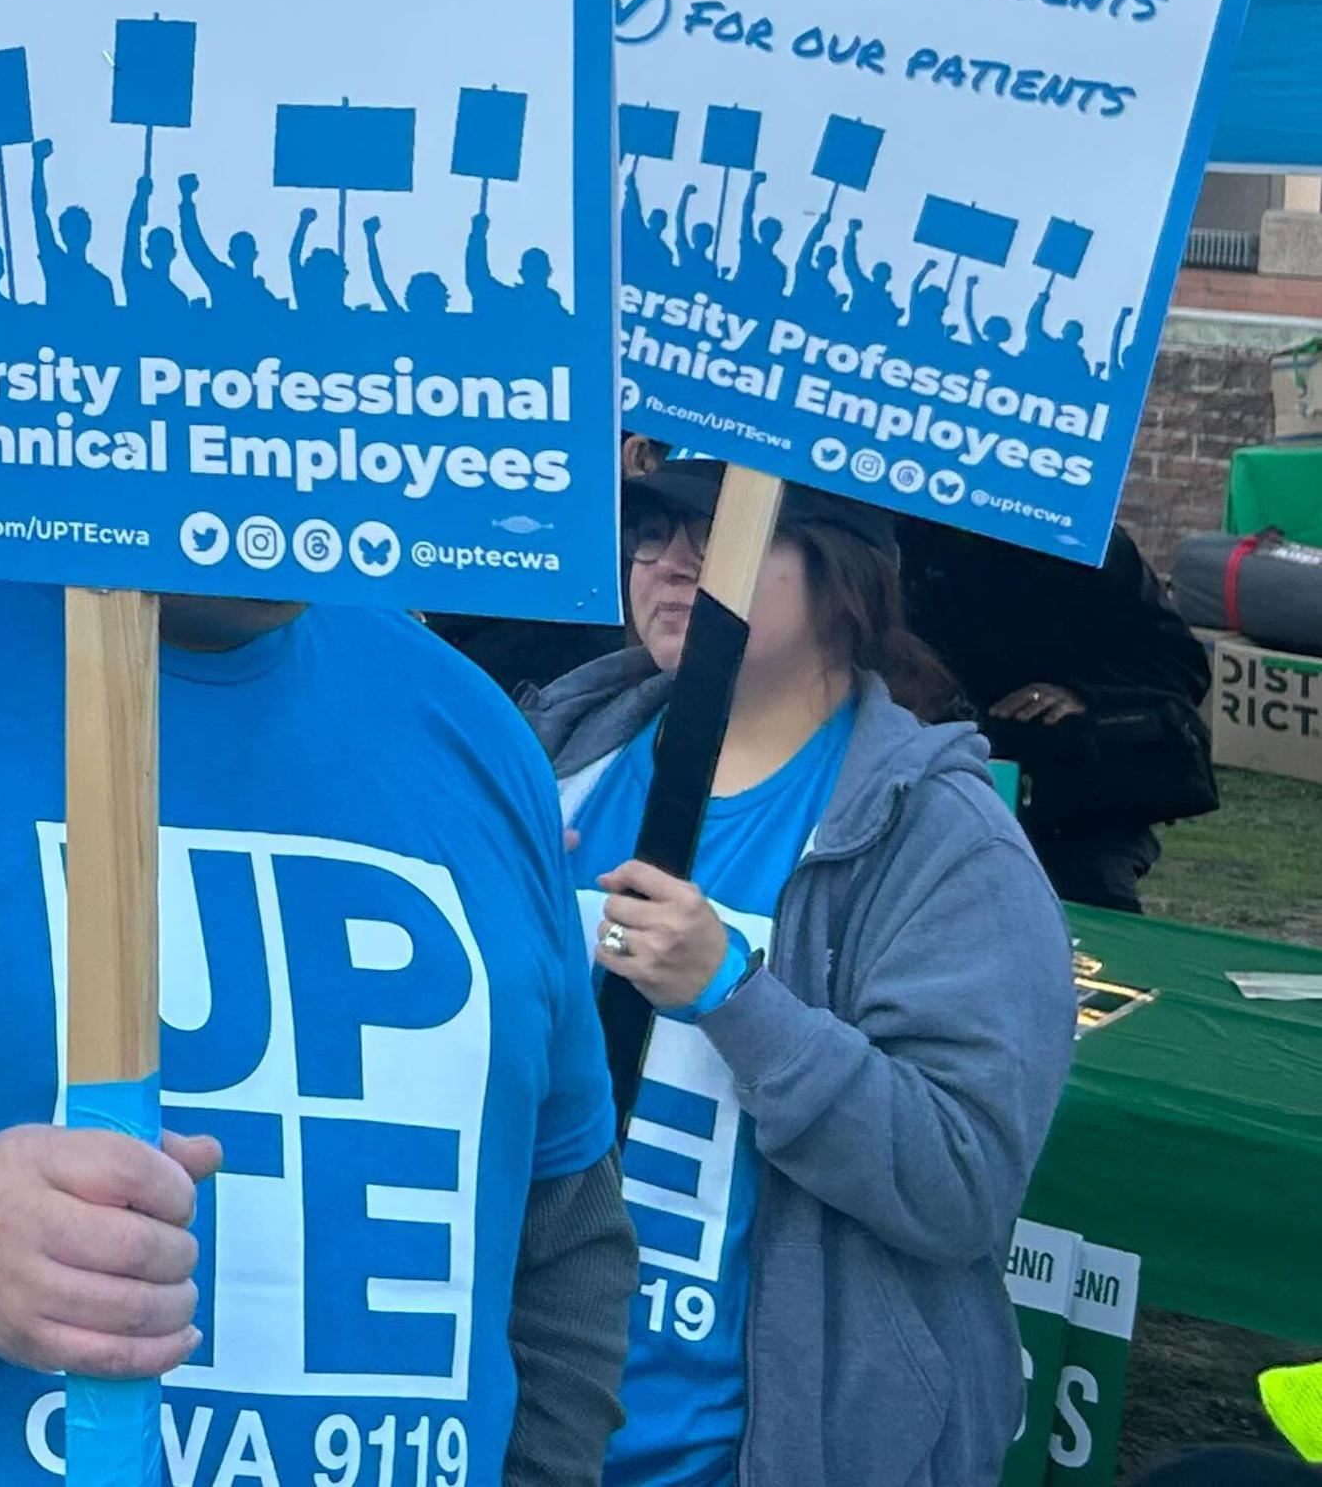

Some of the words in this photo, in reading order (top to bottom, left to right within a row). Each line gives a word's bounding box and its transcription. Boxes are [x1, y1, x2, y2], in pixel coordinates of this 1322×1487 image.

[685, 0, 774, 51] FOR
[792, 26, 886, 73] OUR
[907, 47, 1135, 117] PATIENTS
[138, 356, 571, 421] Professional
[620, 285, 758, 353] ersity
[769, 319, 1109, 442] Professional
[190, 425, 572, 499] Employees
[645, 394, 794, 450] fb.com/UPTEcwa
[971, 487, 1073, 528] @uptecwa
[795, 373, 1094, 487] Employees
[411, 540, 559, 574] @uptecwa
[1222, 691, 1318, 735] RICT
[640, 1277, 715, 1341] 19
[313, 1413, 469, 1487] 9119
